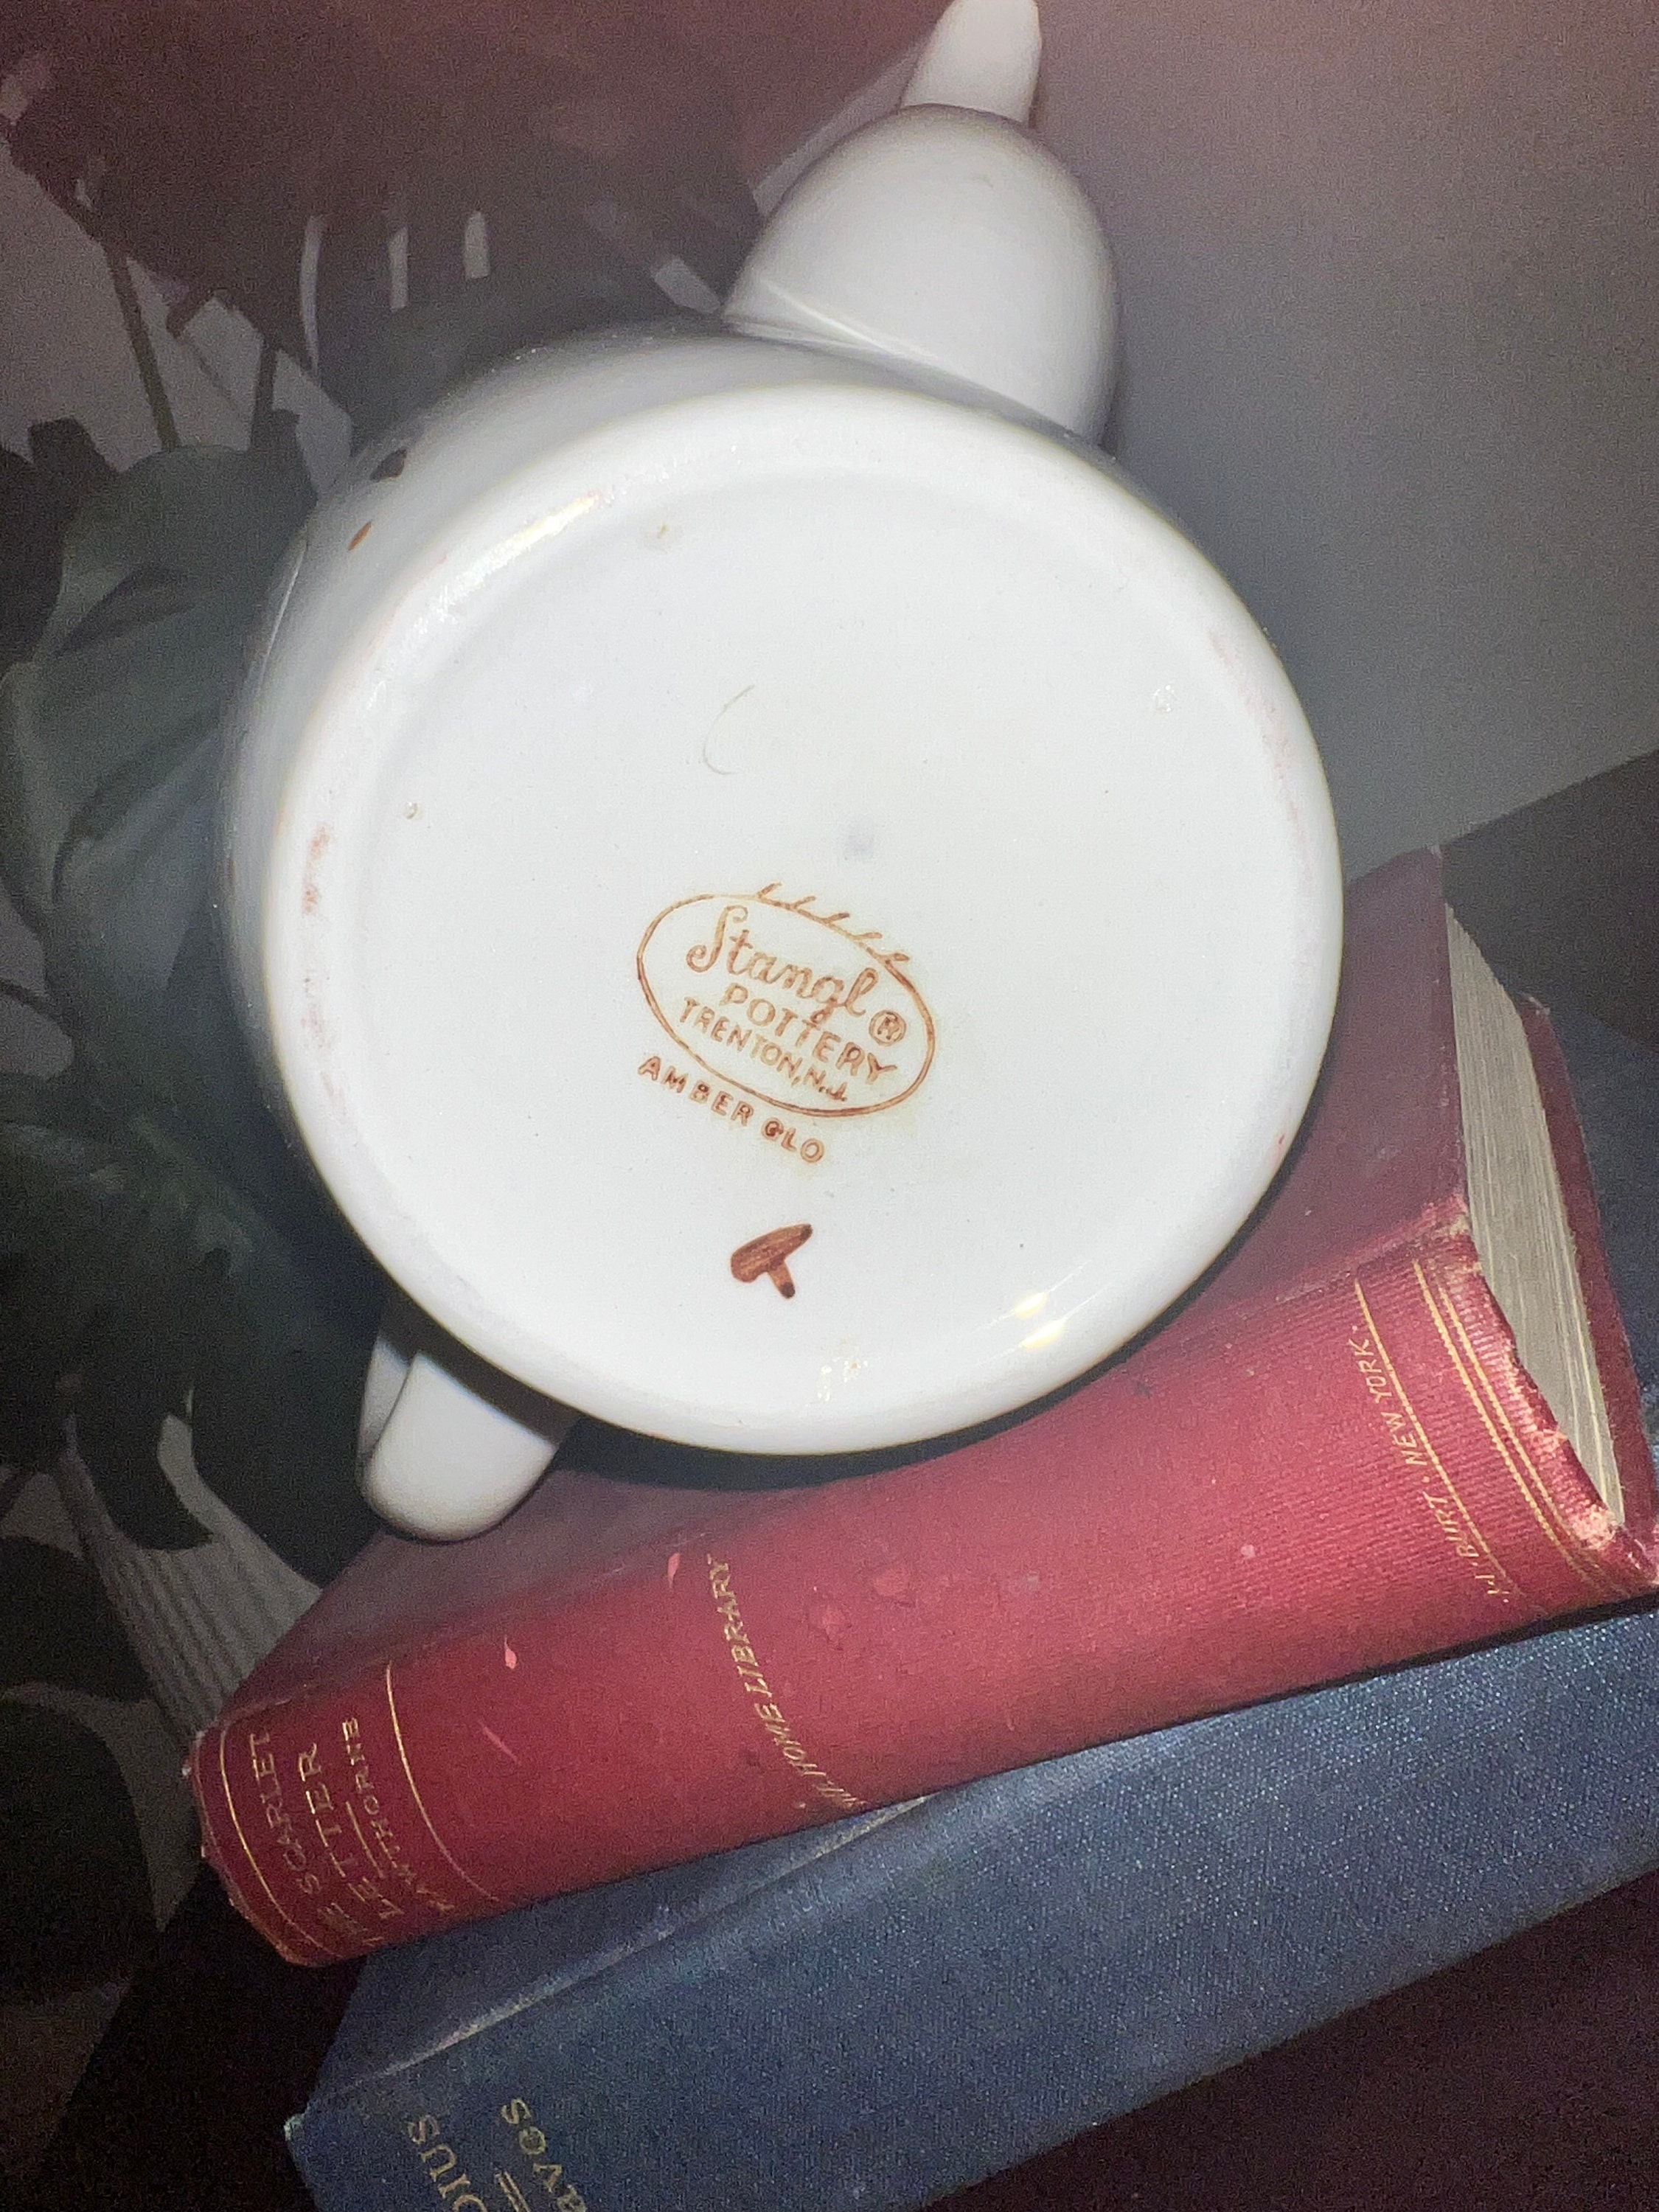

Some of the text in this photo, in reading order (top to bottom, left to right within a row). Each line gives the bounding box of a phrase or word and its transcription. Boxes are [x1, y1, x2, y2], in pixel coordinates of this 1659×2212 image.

[686, 905, 879, 1028] Stangl
[719, 982, 898, 1085] POTTERY
[637, 1056, 825, 1164] AMBER GLO
[1347, 1338, 1392, 1403] YORK
[1381, 1411, 1428, 1466] NEW
[706, 1554, 773, 1697] LIBRARY
[754, 1702, 827, 1777] HOME
[249, 1732, 321, 1895] SCARLET
[298, 1742, 406, 1919] LETTER
